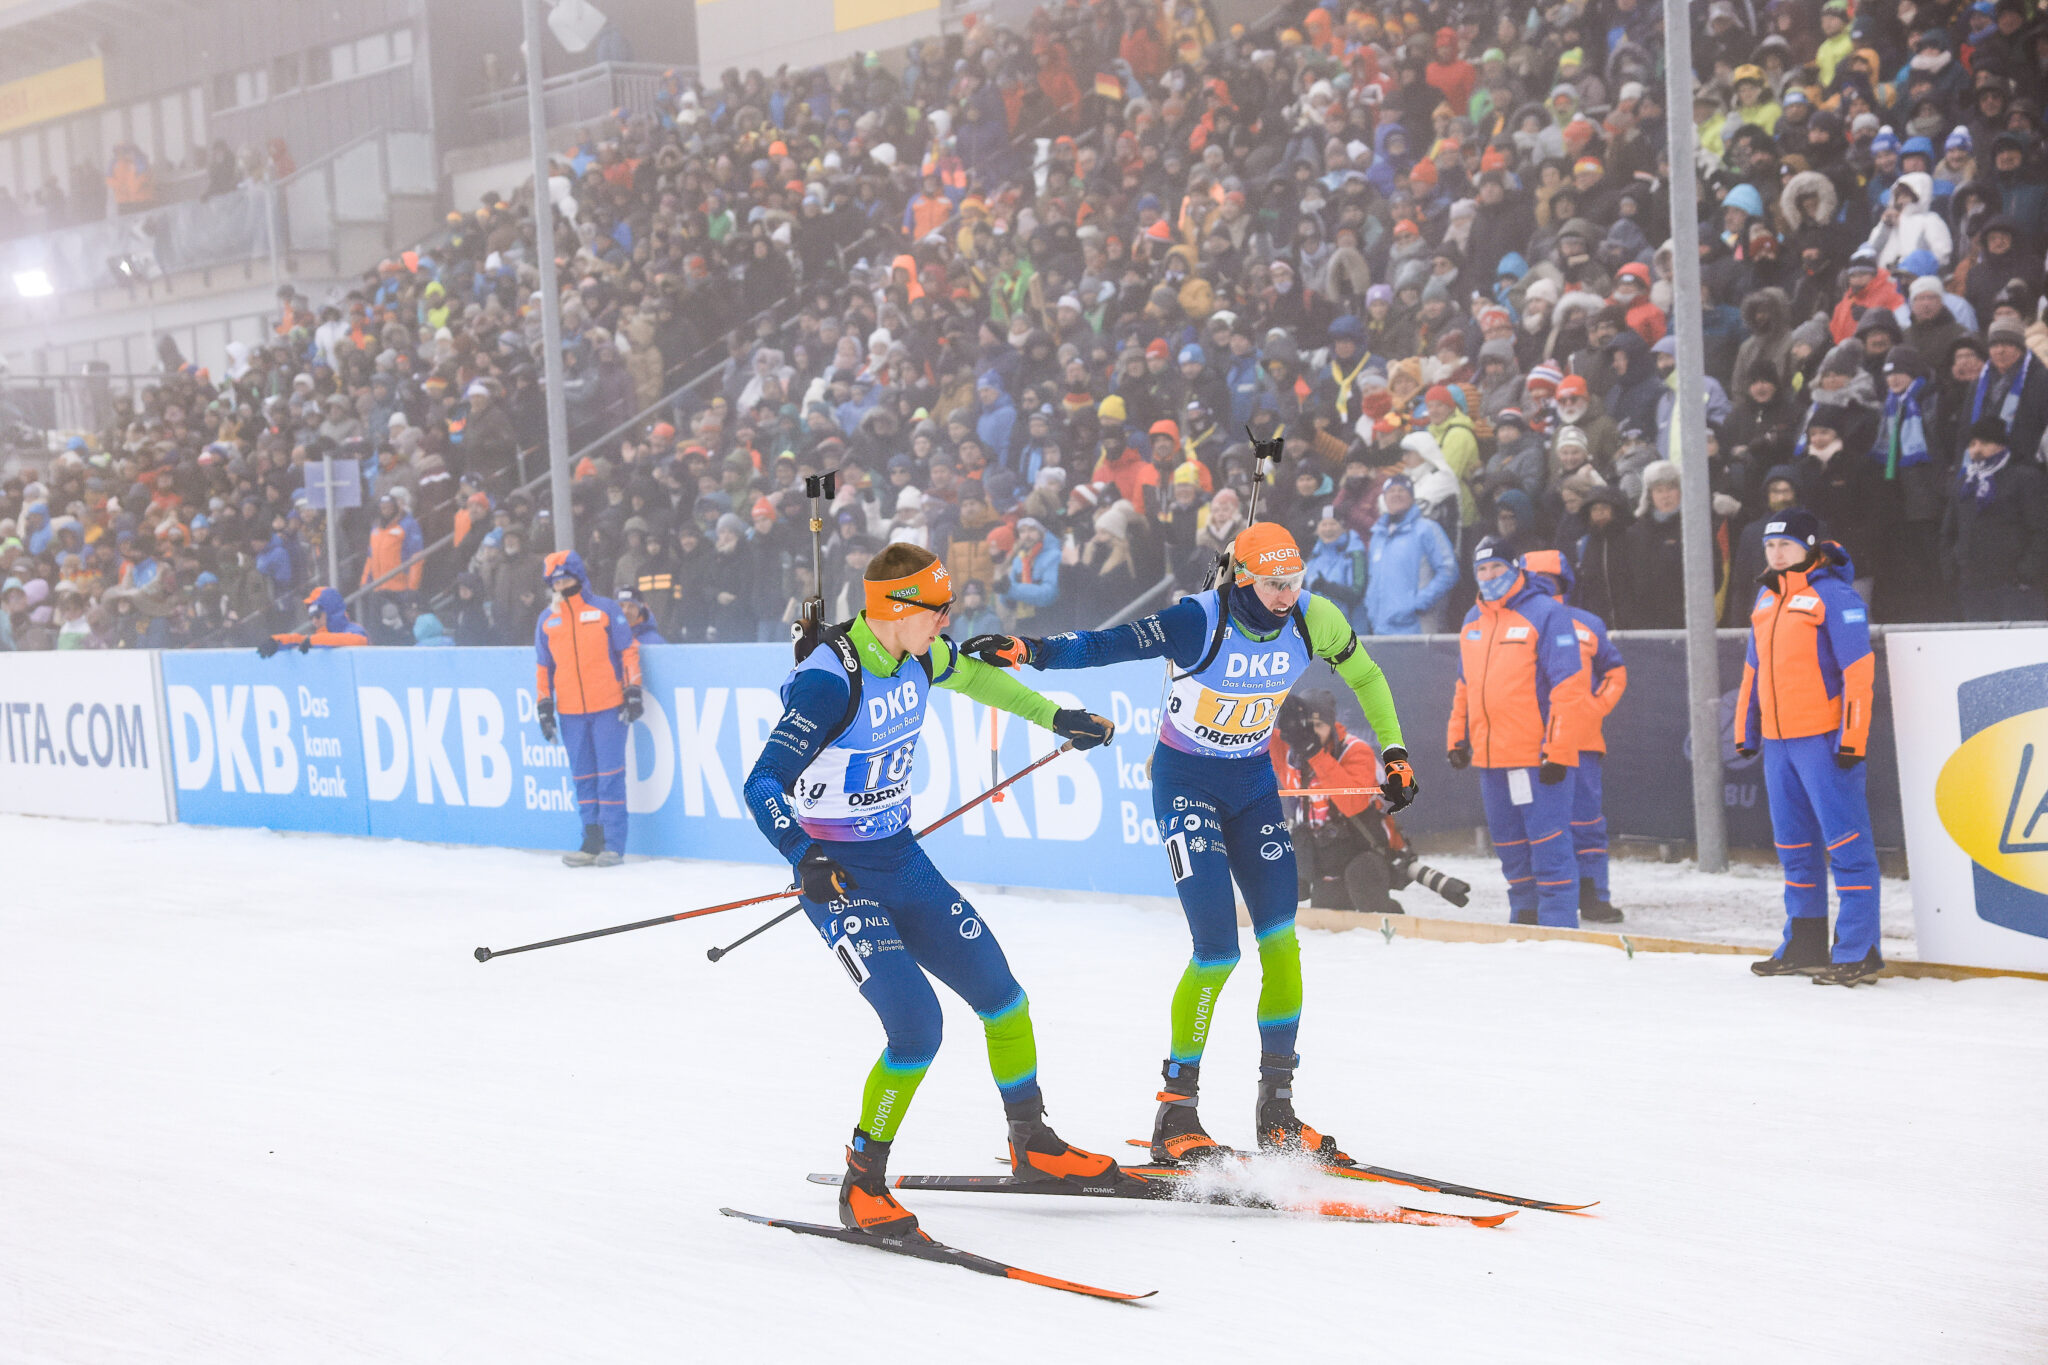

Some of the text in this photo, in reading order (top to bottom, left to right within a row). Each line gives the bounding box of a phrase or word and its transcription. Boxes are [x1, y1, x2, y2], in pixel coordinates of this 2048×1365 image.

[1225, 651, 1291, 678] DKB
[1222, 679, 1287, 689] Das kann Bank
[298, 685, 330, 718] Das
[867, 680, 919, 729] DKB
[1213, 698, 1275, 728] 10
[0, 702, 149, 769] ITA.COM
[168, 684, 299, 795] DKB
[303, 725, 342, 757] kann
[872, 711, 920, 742] Das kann Bank
[357, 686, 512, 808] DKB
[520, 731, 569, 768] kann
[307, 764, 347, 798] Bank
[911, 690, 1103, 842] DKB
[1116, 745, 1151, 790] ka
[523, 774, 576, 812] Bank
[764, 796, 782, 819] ETIS
[1189, 800, 1217, 813] Lumar
[1120, 800, 1159, 846] Ba
[847, 899, 879, 908] Lumar
[865, 917, 890, 928] NLB
[1192, 986, 1213, 1043] SLOVENIA
[870, 1088, 899, 1138] SLOVENIA
[1082, 1186, 1116, 1194] ATOMIC
[882, 1238, 903, 1247] ATOMIC
